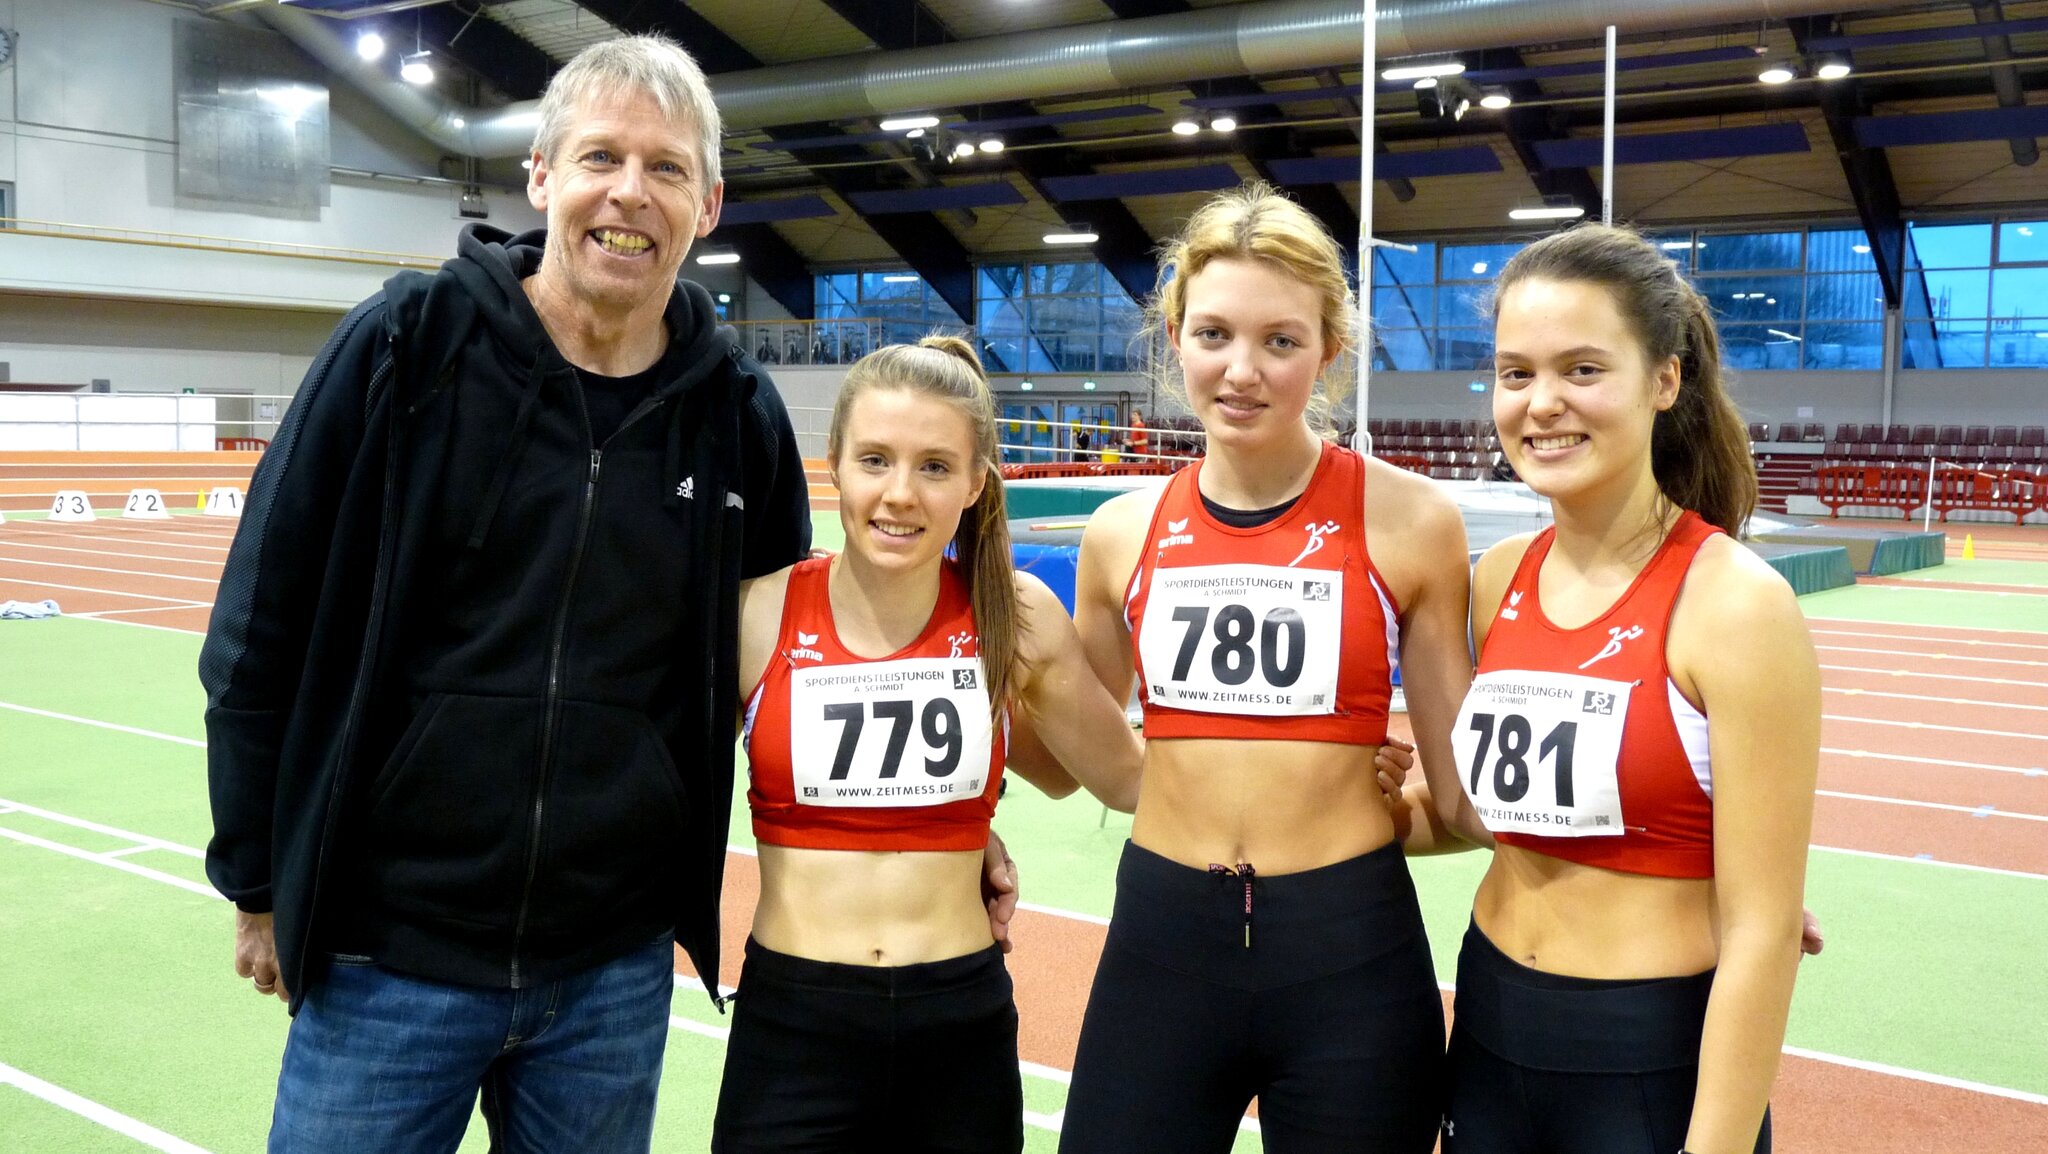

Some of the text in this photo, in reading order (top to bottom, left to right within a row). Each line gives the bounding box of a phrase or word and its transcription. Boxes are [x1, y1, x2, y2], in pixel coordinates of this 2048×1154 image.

[1164, 577, 1293, 590] SPORTDIENSTLEISTUNGEN
[1212, 588, 1247, 597] SCHMIDT
[1171, 604, 1306, 688] 780
[805, 671, 945, 687] SPORTDIENSTLEISTUNGEN
[864, 684, 904, 692] SCHMIDT
[1177, 689, 1292, 705] WWW.ZEITMESS.DE
[823, 697, 963, 781] 779
[1469, 712, 1578, 808] 781
[836, 783, 954, 797] WWW.ZEITMESS.DE
